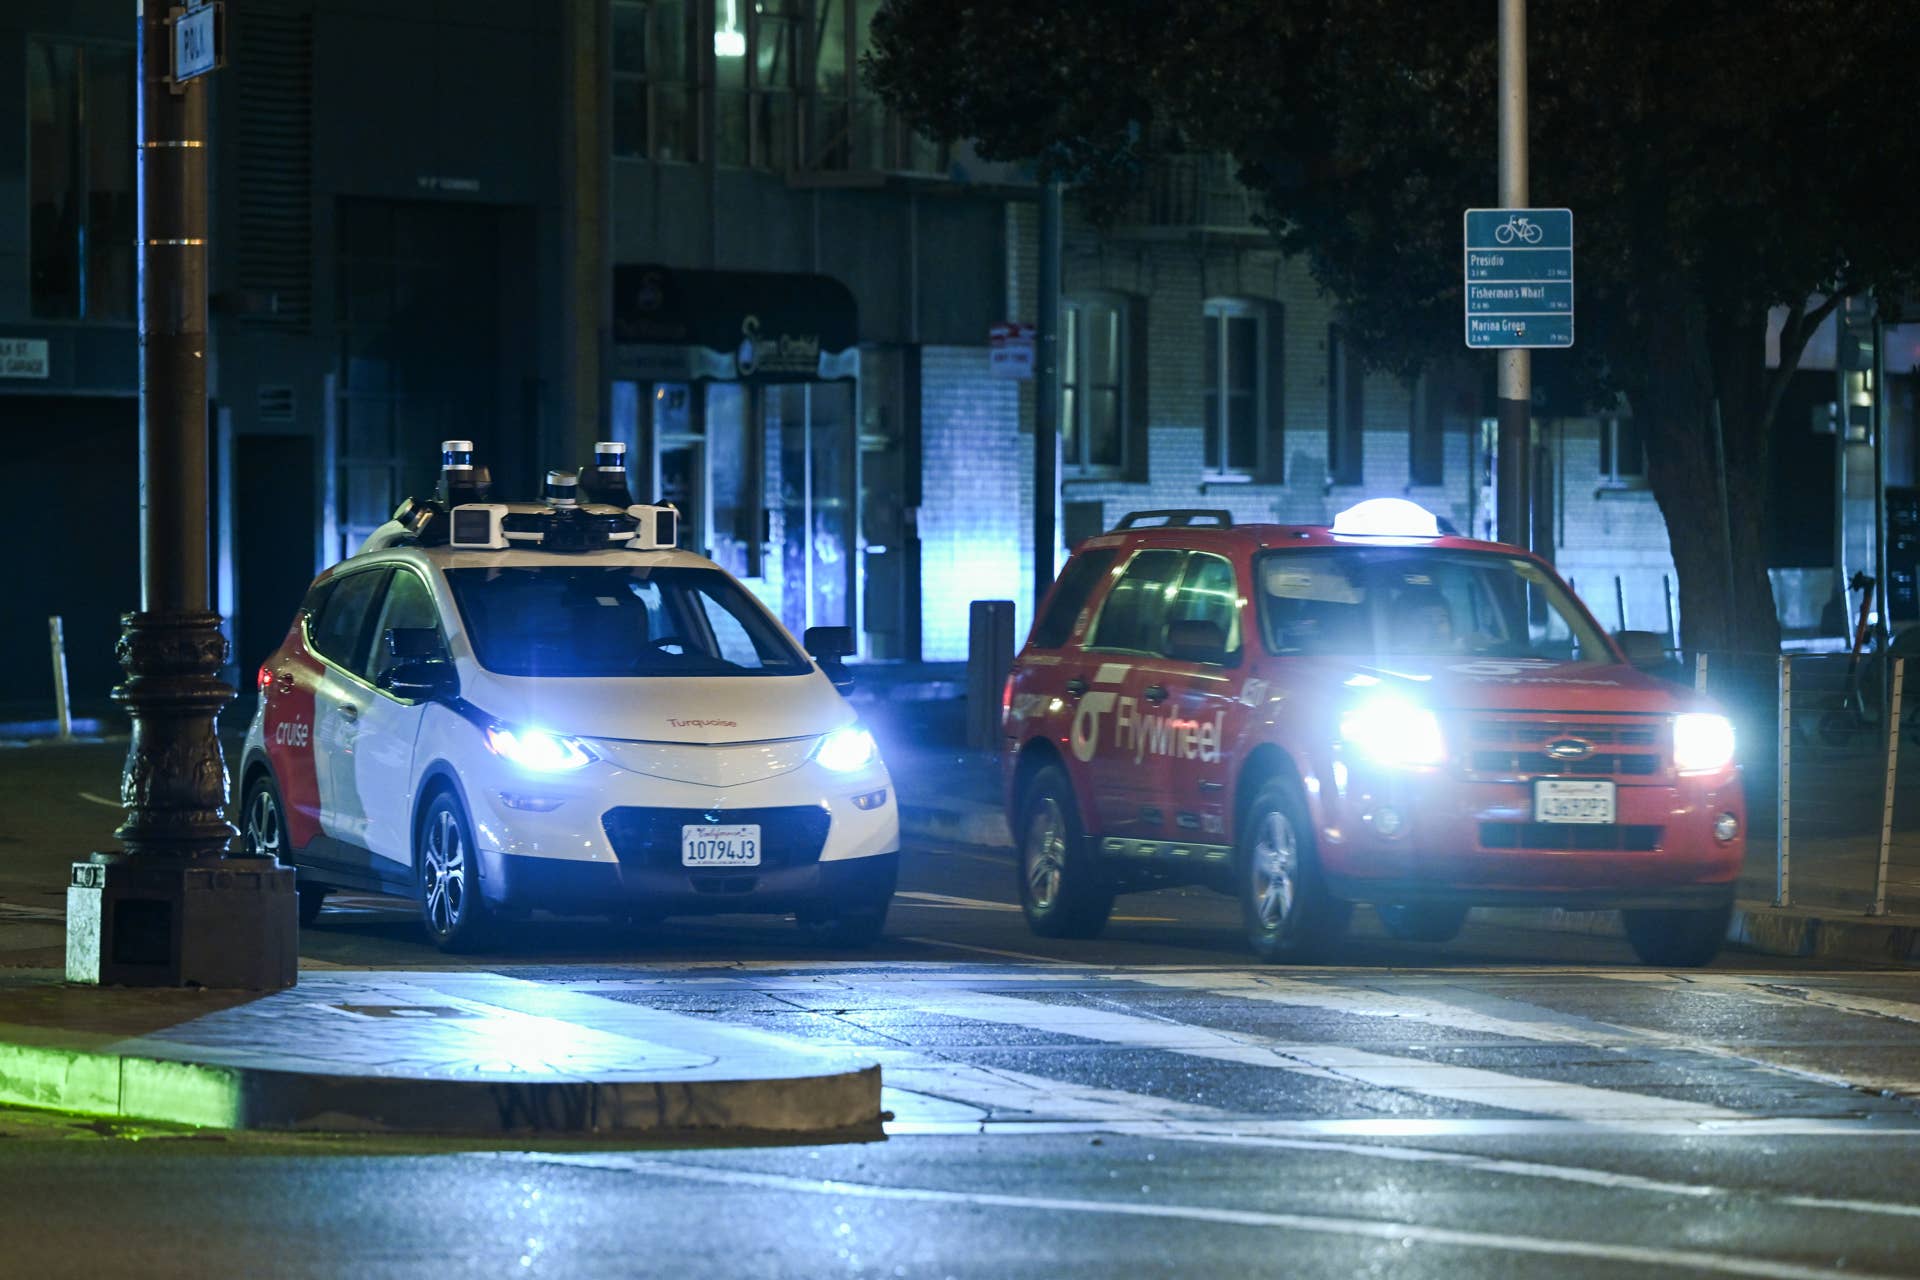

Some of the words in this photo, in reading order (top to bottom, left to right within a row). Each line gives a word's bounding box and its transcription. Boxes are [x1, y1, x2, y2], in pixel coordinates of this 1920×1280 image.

[1471, 254, 1504, 266] Presidio
[1471, 287, 1519, 299] Fisherman's
[1520, 286, 1545, 299] Wharf
[1471, 319, 1500, 332] Marina
[1502, 319, 1526, 332] Green
[276, 713, 309, 747] cruise
[666, 718, 738, 729] Turquoise
[1115, 695, 1226, 766] Flywheel
[687, 840, 756, 861] 10794J3
